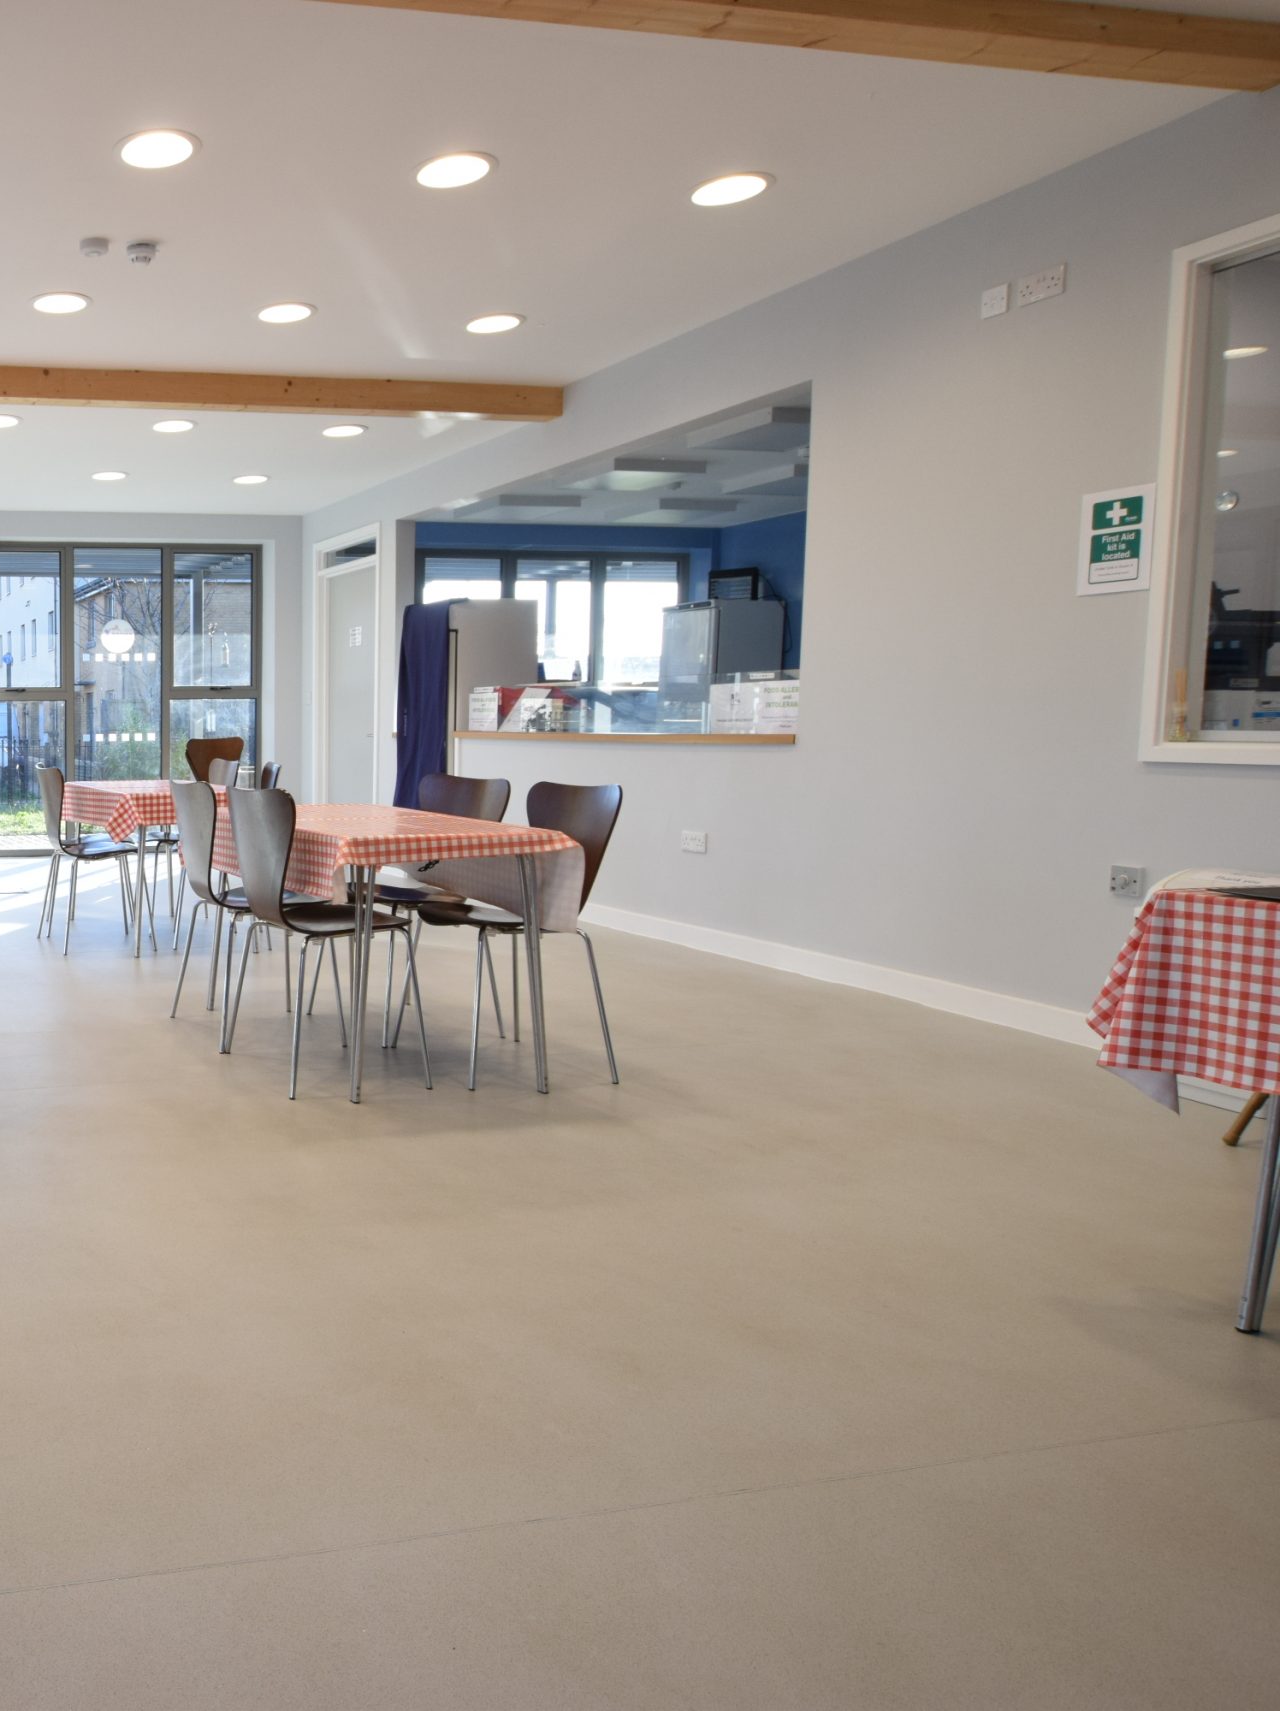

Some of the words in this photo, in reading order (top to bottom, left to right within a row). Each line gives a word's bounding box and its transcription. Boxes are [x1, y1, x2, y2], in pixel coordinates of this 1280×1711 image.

[1102, 534, 1119, 544] First
[1121, 532, 1135, 541] Aid
[1107, 543, 1117, 552] kit
[1118, 542, 1126, 550] is
[1102, 550, 1130, 561] located
